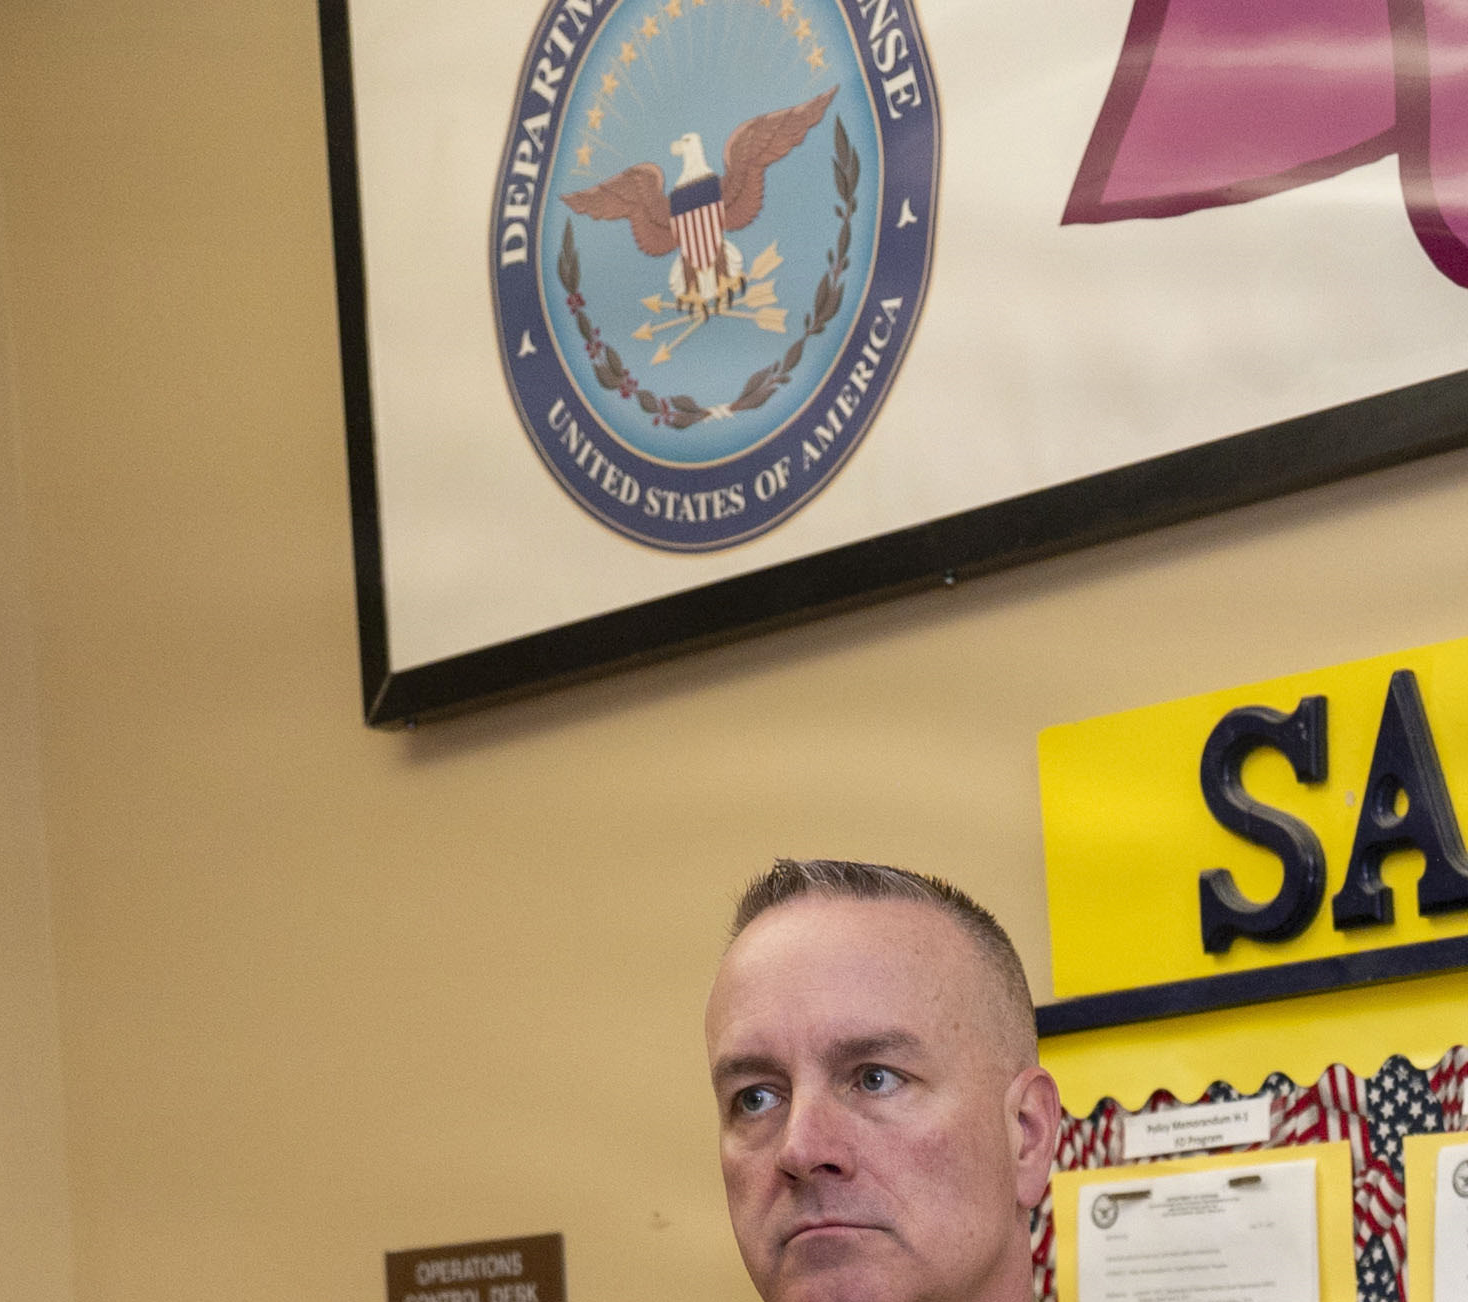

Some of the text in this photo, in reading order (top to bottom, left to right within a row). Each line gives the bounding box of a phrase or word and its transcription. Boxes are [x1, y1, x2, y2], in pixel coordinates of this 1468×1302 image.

[547, 293, 906, 523] UNITED STATES OF AMERICA
[416, 1252, 522, 1285] OPERATIONS
